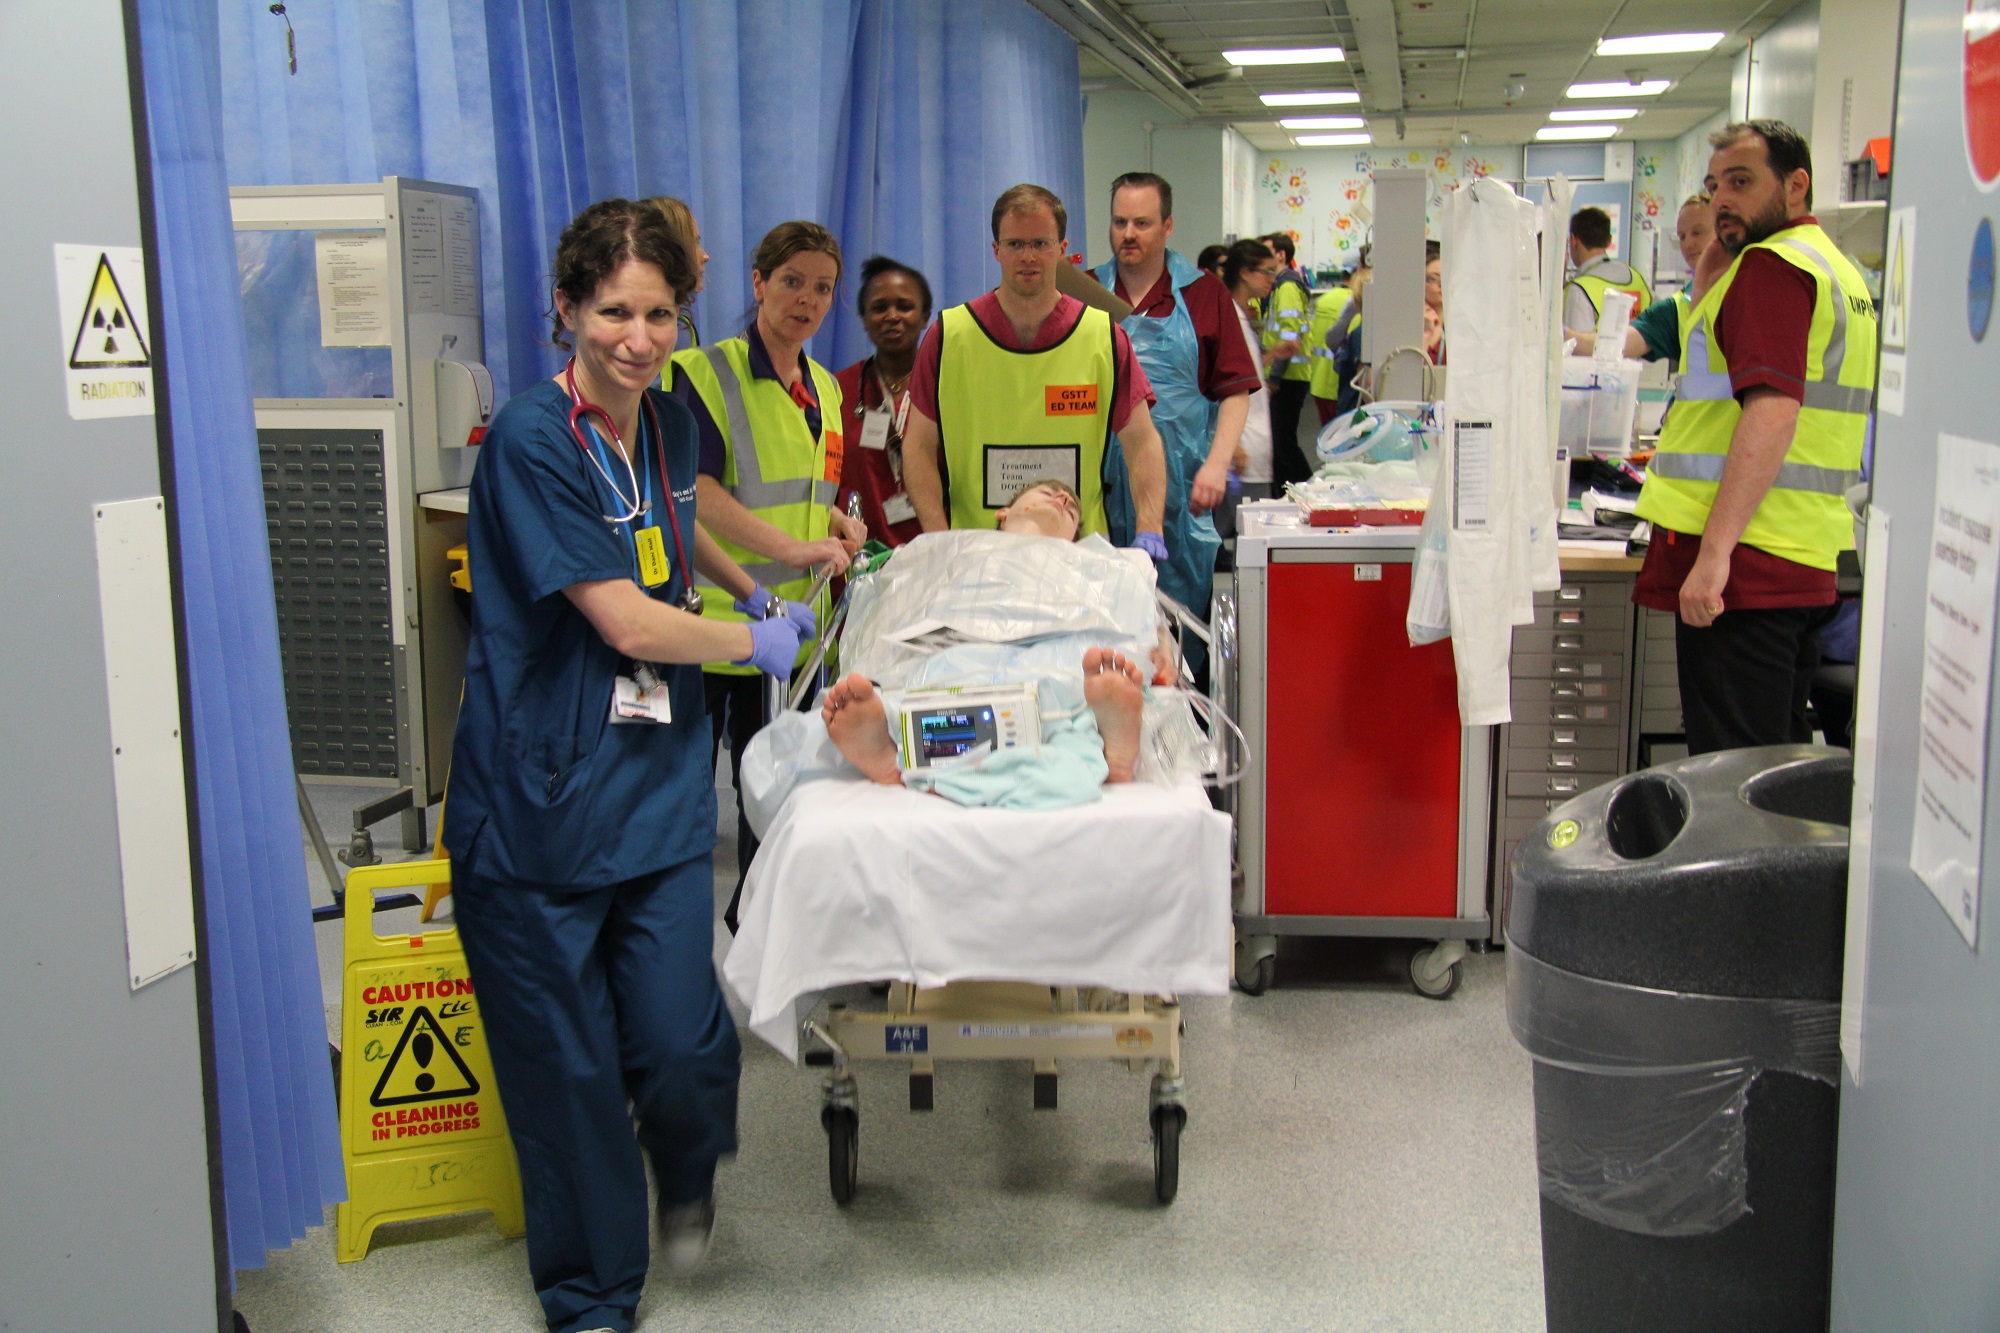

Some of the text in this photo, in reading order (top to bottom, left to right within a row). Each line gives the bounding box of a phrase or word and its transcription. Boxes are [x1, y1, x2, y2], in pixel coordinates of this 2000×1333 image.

[81, 380, 147, 400] RADIATION
[1061, 390, 1088, 400] GSTT
[1051, 401, 1096, 411] ED TEAM
[1001, 462, 1042, 470] Treatment
[362, 977, 474, 1005] CAUTION
[365, 1007, 404, 1024] SIR
[892, 1025, 920, 1040] A&E
[372, 1101, 479, 1128] CLEANING
[372, 1117, 481, 1141] IN PROGRESS
